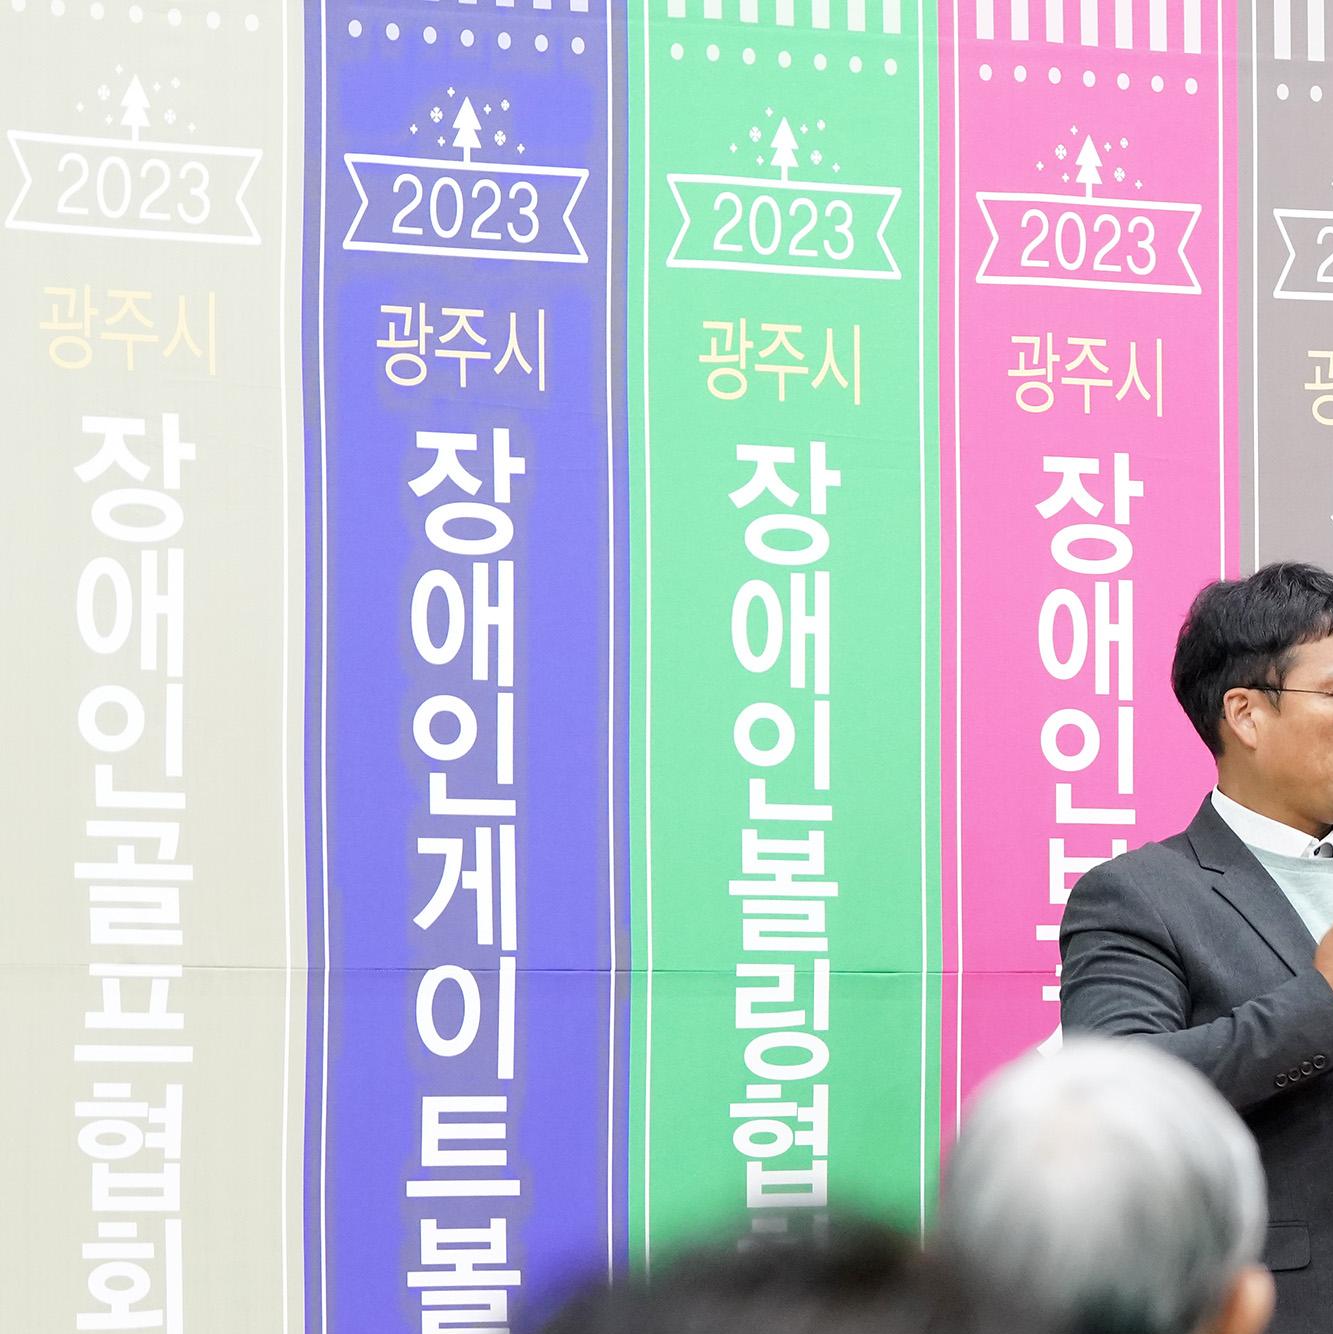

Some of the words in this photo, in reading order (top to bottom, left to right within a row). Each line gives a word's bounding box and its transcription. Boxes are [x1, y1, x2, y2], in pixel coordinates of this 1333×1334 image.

[57, 152, 211, 225] 2023
[391, 173, 541, 245] 2023
[712, 191, 855, 262] 2023
[1019, 208, 1158, 277] 2023
[40, 284, 216, 376] 광주시
[376, 302, 546, 391] 광주시
[699, 318, 861, 405] 광주시
[1008, 332, 1163, 417] 광주시
